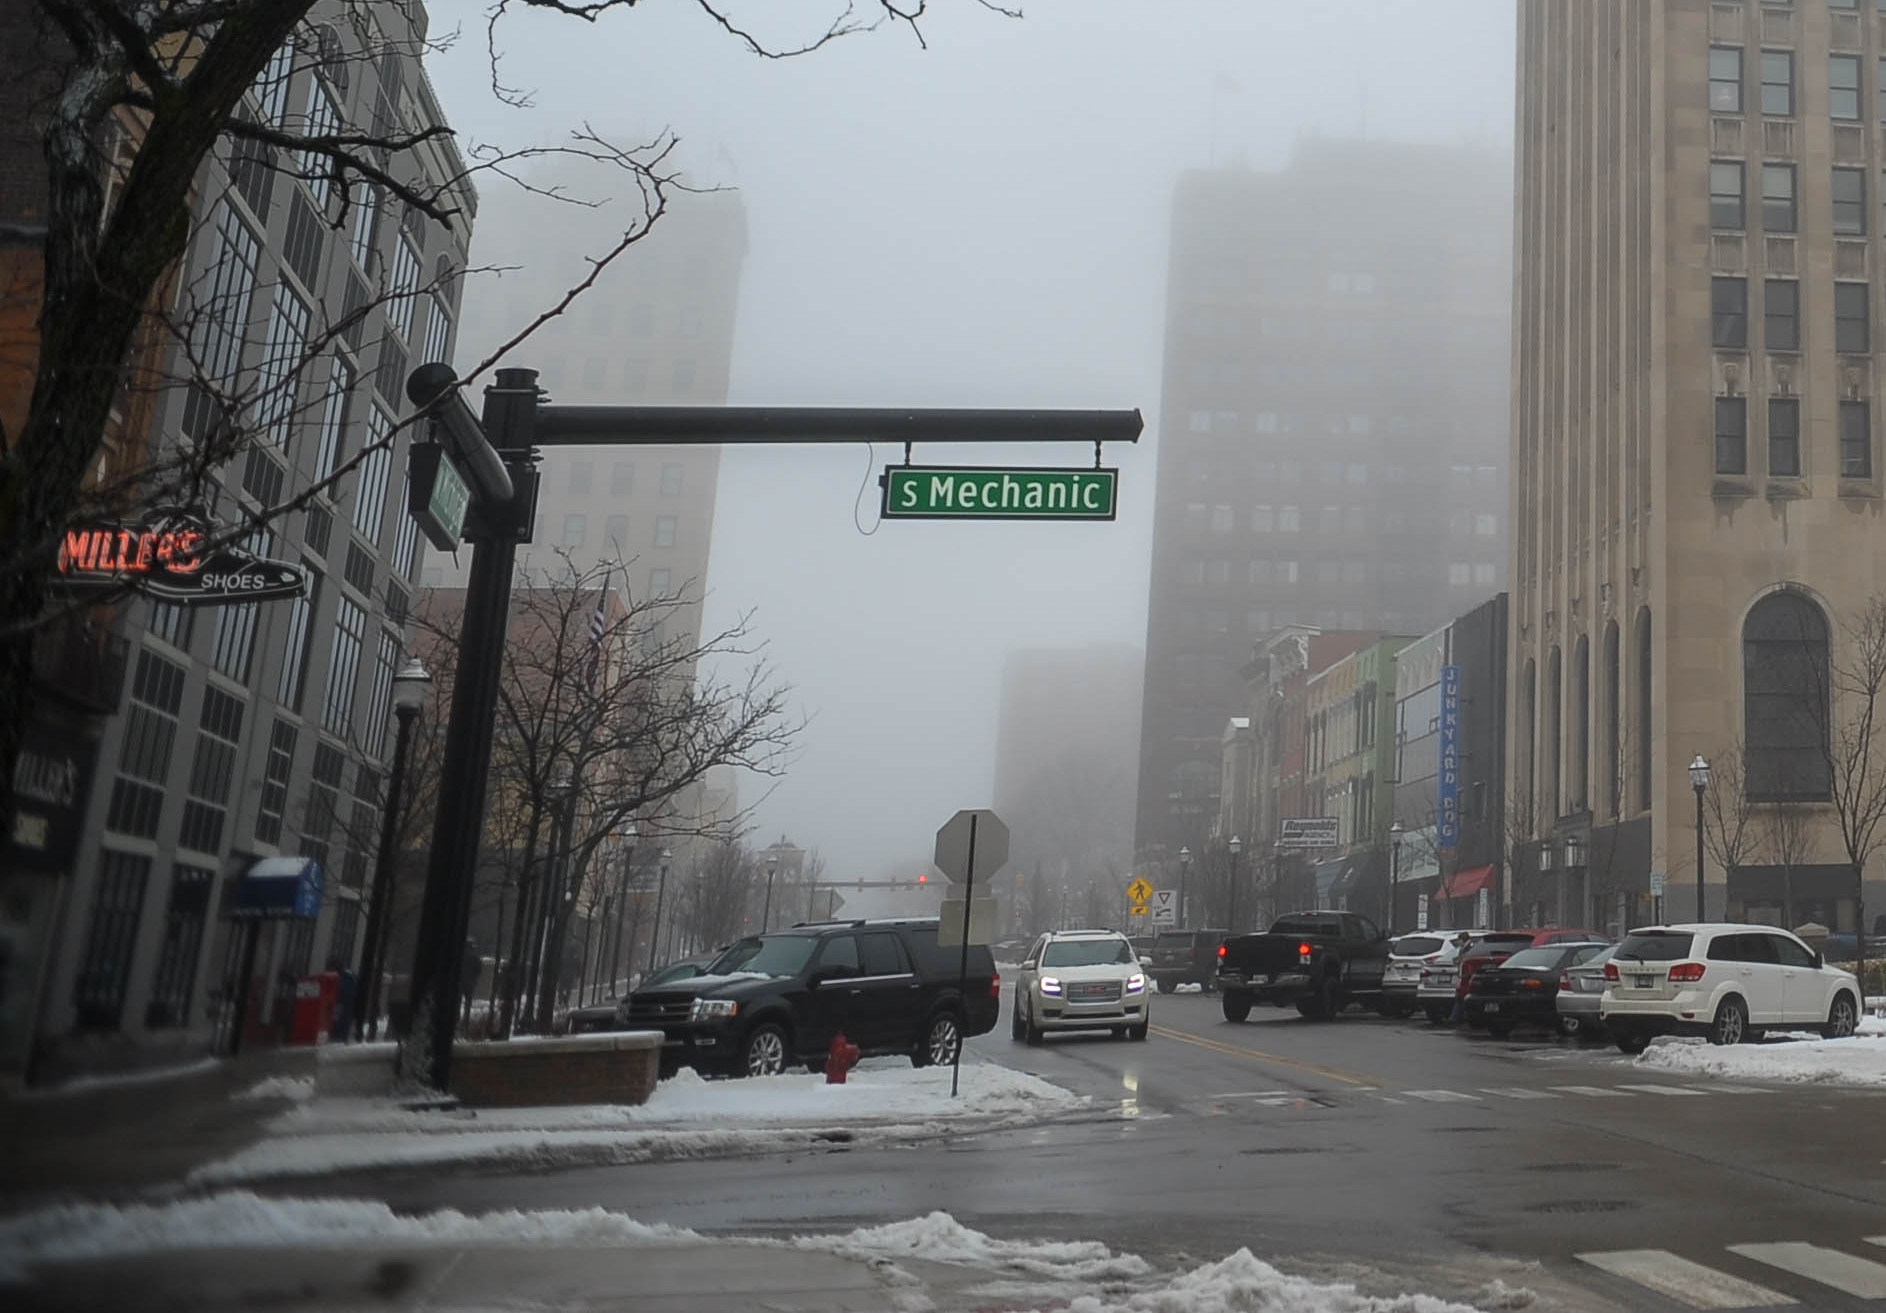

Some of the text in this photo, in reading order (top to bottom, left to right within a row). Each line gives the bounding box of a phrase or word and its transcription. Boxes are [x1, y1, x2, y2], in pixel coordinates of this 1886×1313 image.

[900, 474, 1101, 509] S Mechanic
[200, 573, 266, 590] SHOES
[1443, 668, 1457, 784] JUNKYARD
[1441, 796, 1456, 837] DOG
